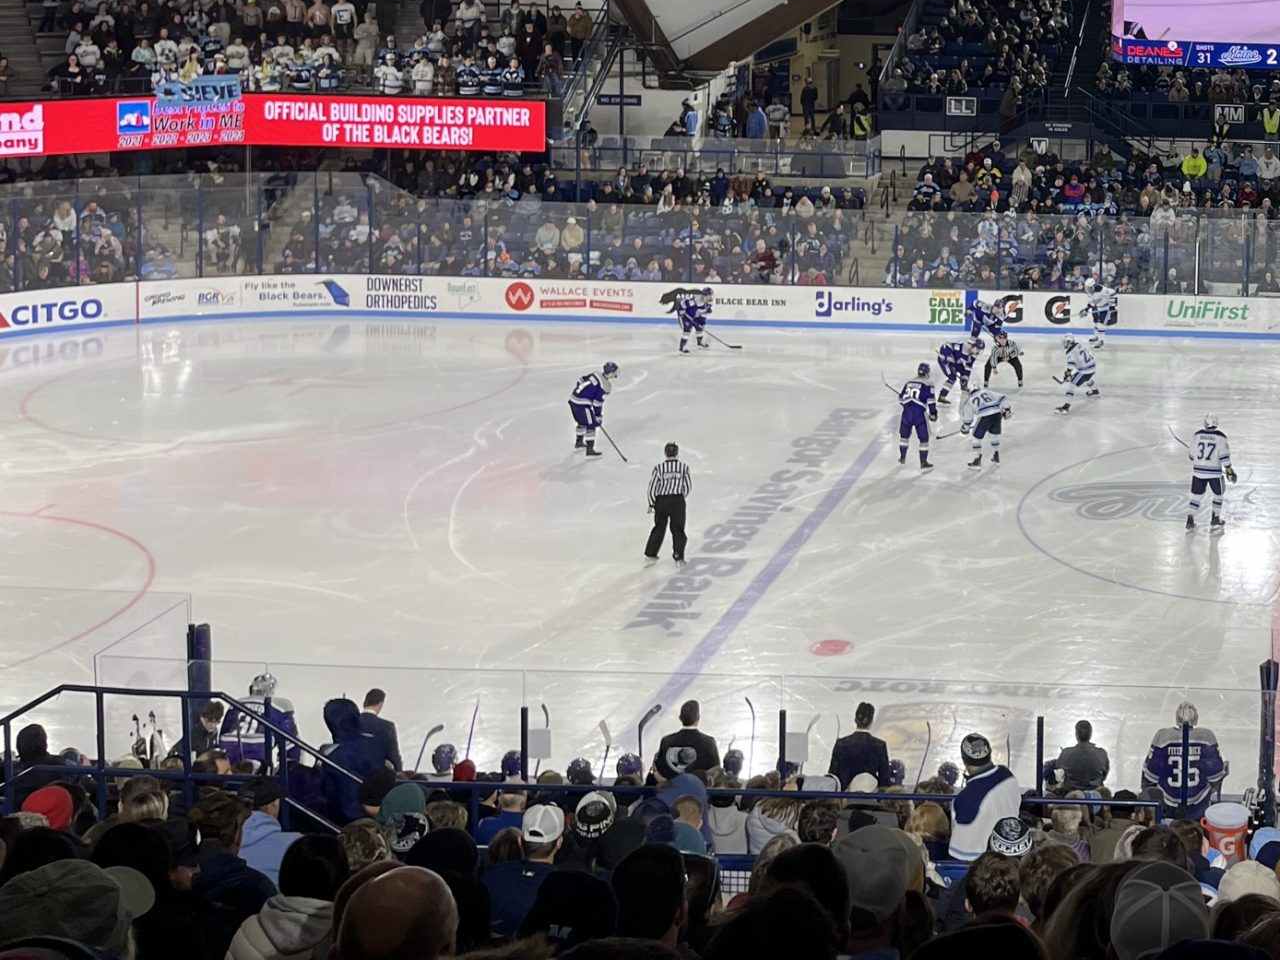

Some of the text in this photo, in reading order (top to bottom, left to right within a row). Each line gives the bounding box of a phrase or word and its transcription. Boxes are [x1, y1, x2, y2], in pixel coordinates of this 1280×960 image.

[1195, 44, 1214, 52] SHOTS
[1127, 56, 1183, 65] DETAILING
[1197, 53, 1211, 64] 31
[1266, 48, 1278, 65] 2
[181, 85, 240, 103] SIEVE
[264, 100, 530, 127] OFFICIAL BUILDING SUPPLIES PARTNER
[950, 99, 972, 113] LL
[1216, 106, 1242, 121] MM
[0, 104, 43, 133] nd
[154, 113, 244, 132] Work in ME
[322, 123, 473, 145] OF THE BLACK BEARS!
[0, 137, 38, 150] any
[1032, 140, 1047, 155] M
[244, 280, 296, 292] Fly like the
[366, 277, 424, 293] DOWNEAST
[539, 286, 634, 298] WALLACE EVENTS
[259, 290, 326, 301] Black Bears.
[366, 294, 437, 310] ORTHOPEDICS
[715, 297, 787, 307] BLACK BEAR INN
[929, 297, 964, 309] CALL
[11, 298, 103, 326] CITGO
[928, 308, 964, 325] JOE
[1044, 295, 1071, 325] G
[1166, 300, 1249, 321] UniFirst
[902, 387, 920, 399] 20
[972, 393, 992, 407] 26
[1197, 442, 1217, 461] 37
[623, 557, 751, 631] Bank
[1167, 756, 1200, 788] 35
[1219, 836, 1236, 856] G
